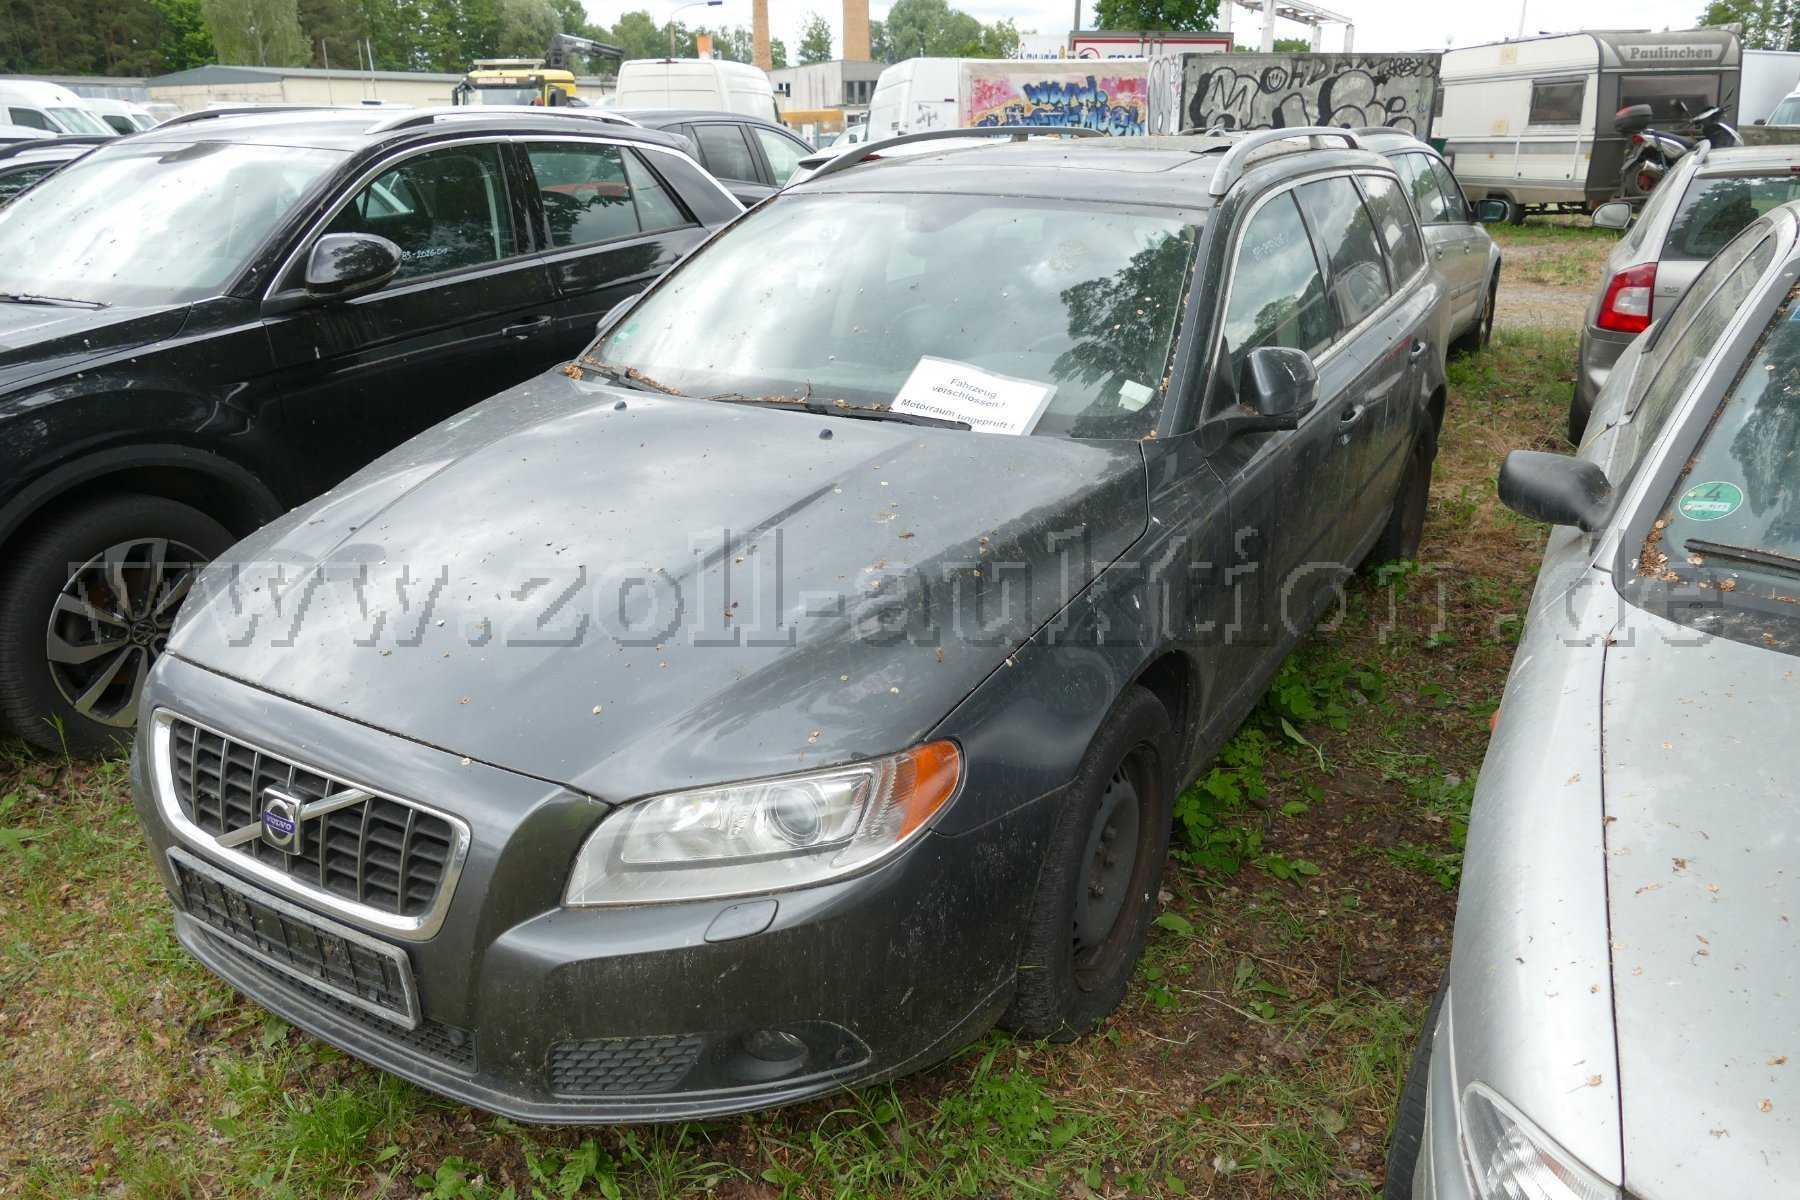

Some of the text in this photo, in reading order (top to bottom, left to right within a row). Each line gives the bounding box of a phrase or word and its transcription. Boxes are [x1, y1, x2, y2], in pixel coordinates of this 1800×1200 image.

[1630, 46, 1713, 60] Paulinchen
[932, 385, 999, 408] verschlossen
[950, 378, 997, 399] Fahrzeug
[901, 398, 955, 417] Motorraum
[1703, 484, 1721, 501] 4
[265, 814, 292, 832] VOLVO
